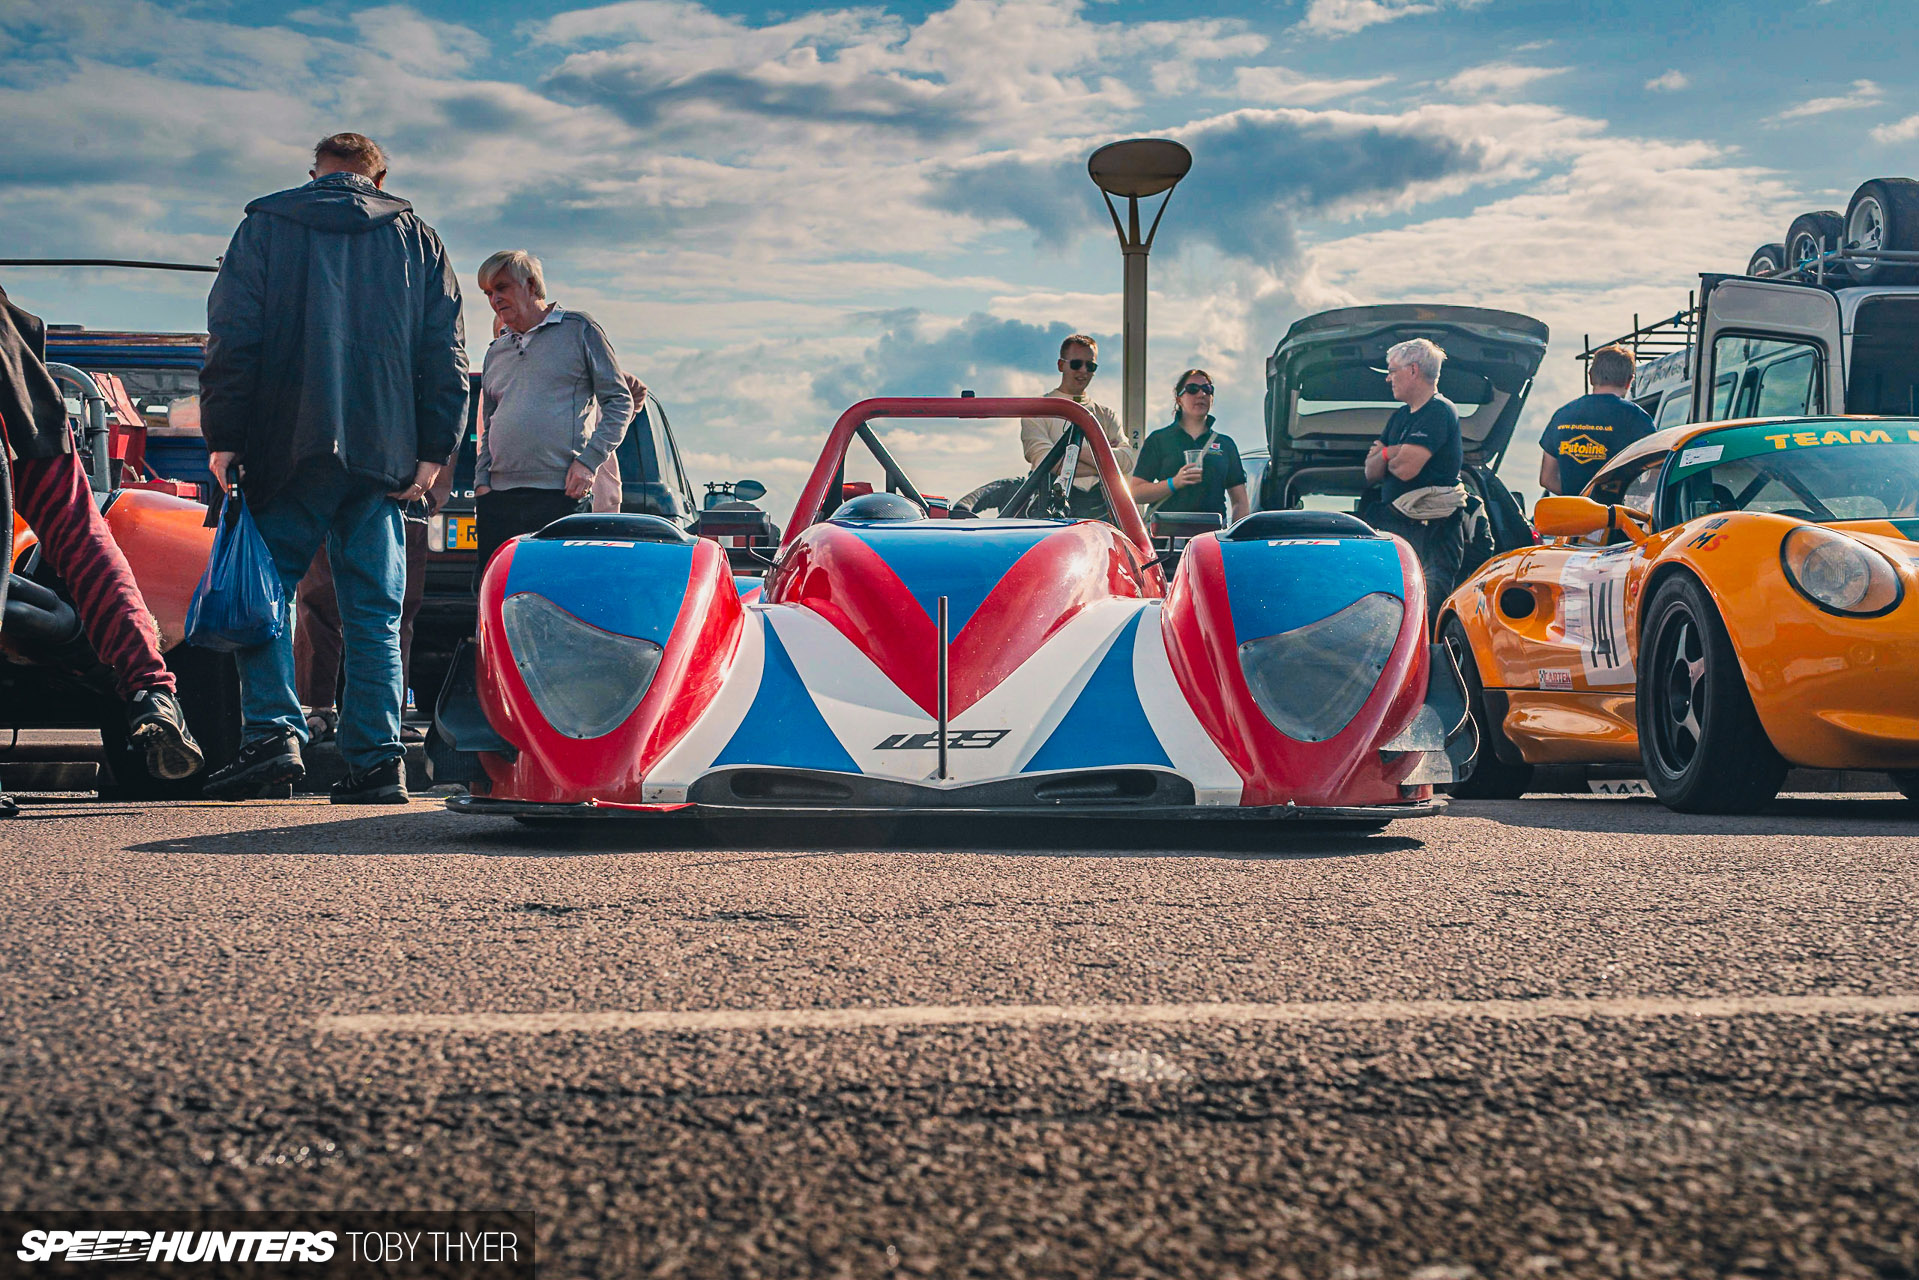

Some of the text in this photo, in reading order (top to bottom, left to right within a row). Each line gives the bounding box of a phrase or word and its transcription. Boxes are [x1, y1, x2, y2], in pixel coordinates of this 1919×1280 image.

[1559, 440, 1606, 455] Putoline
[1764, 430, 1893, 450] TEAM
[1588, 578, 1620, 669] 141
